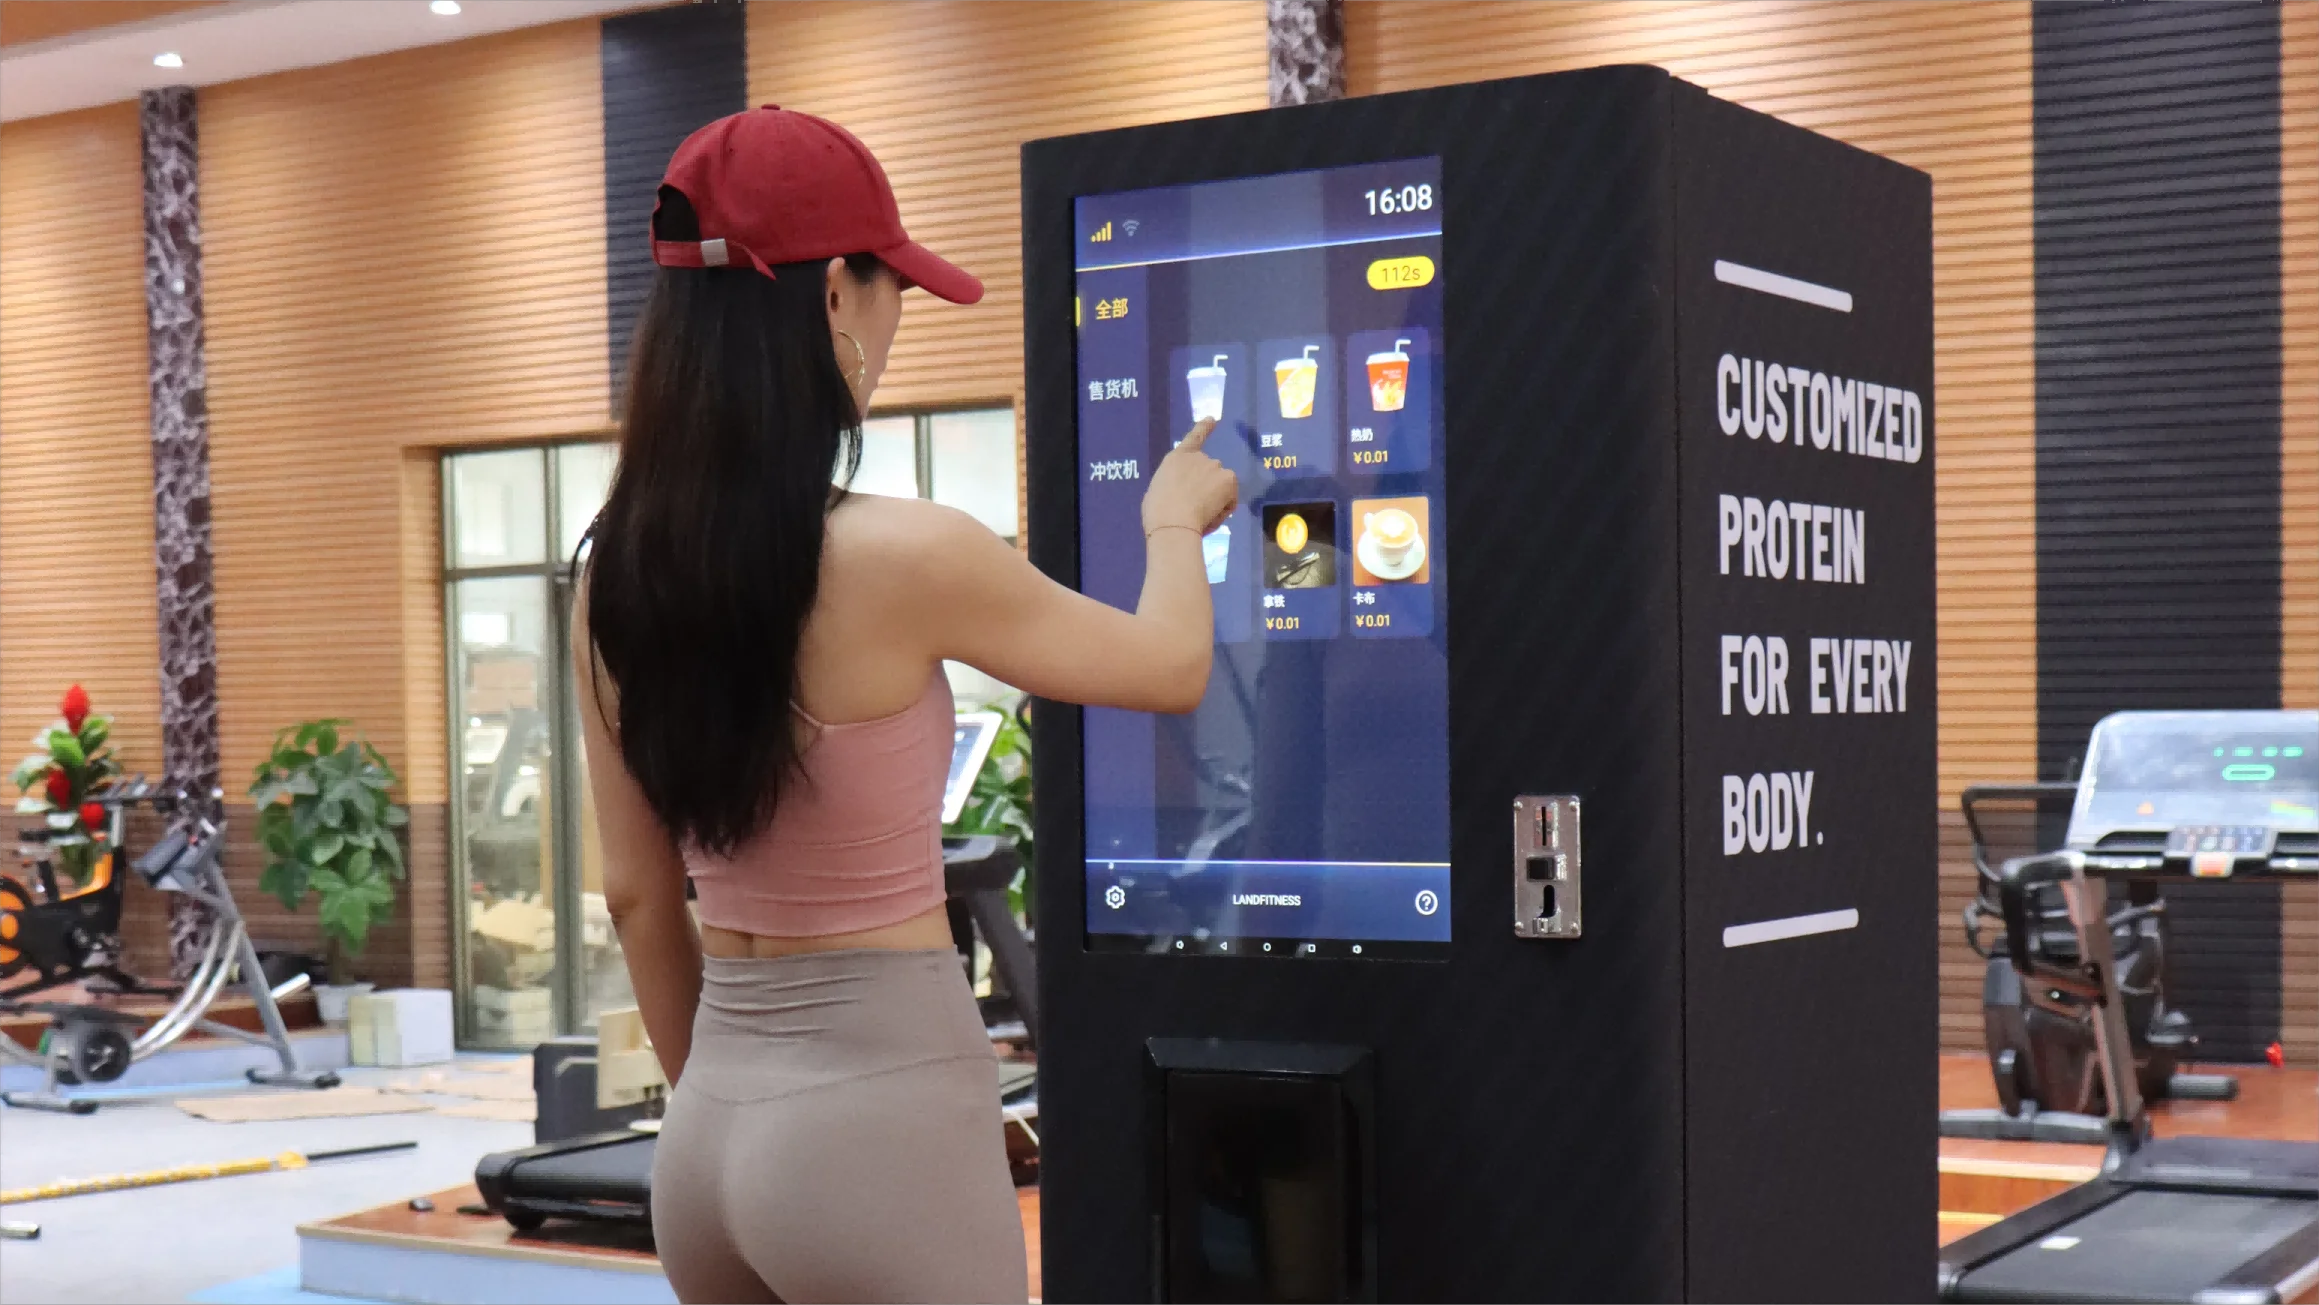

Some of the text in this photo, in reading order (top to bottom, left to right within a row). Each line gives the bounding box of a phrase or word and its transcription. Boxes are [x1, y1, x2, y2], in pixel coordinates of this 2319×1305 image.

[1365, 184, 1433, 216] 16:08
[1382, 265, 1421, 283] 112s
[1095, 298, 1129, 320] 全部
[1088, 378, 1138, 401] 售货机
[1716, 353, 1923, 464] CUSTOMIZED
[1261, 433, 1283, 448] 豆浆
[1089, 460, 1139, 481] 冲饮机
[1719, 494, 1865, 584] PROTEIN
[1263, 594, 1285, 608] 拿铁
[1352, 591, 1375, 605] 卡布
[1721, 634, 1912, 715] FOR EVERY
[1723, 771, 1824, 856] BODY.
[1232, 894, 1302, 906] LANDFITNESS
